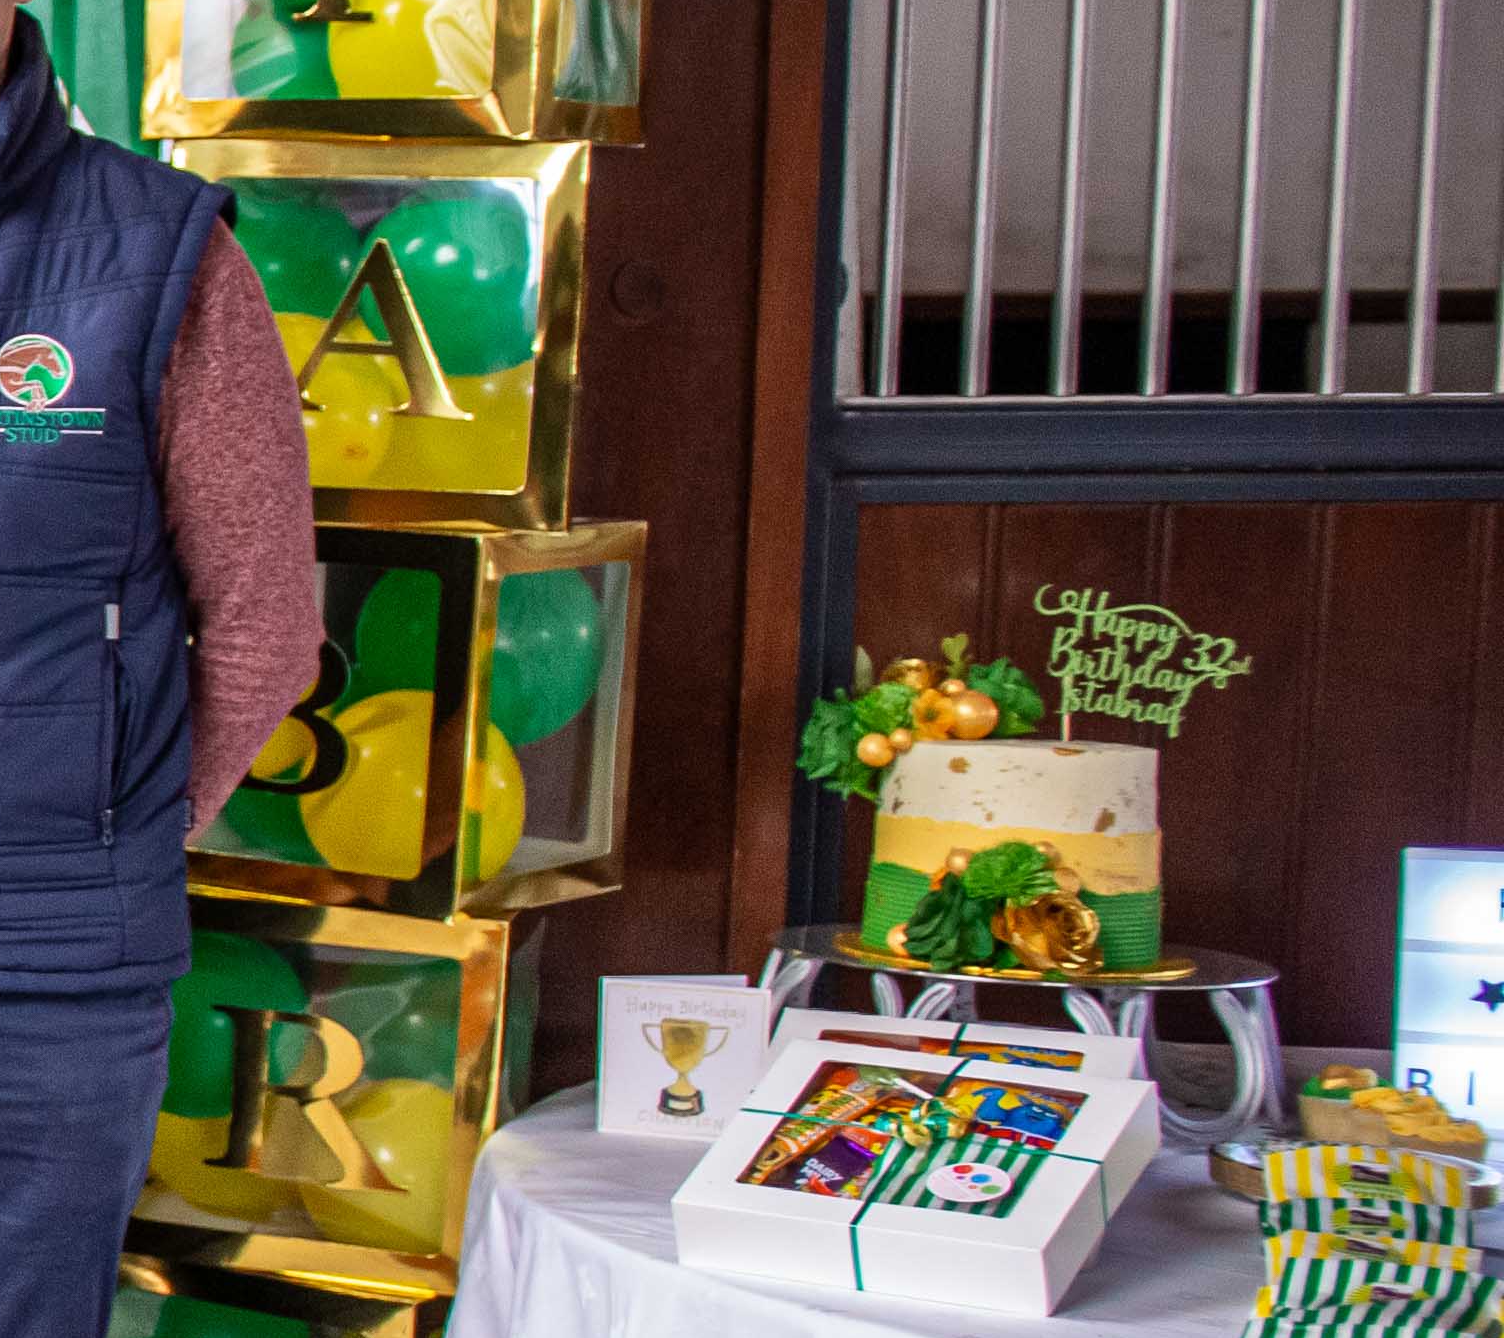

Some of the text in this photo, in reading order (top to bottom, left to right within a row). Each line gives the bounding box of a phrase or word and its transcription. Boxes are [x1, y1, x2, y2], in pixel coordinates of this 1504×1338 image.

[4, 426, 60, 443] STUD
[1035, 584, 1182, 659] Happy
[1047, 626, 1196, 707] Birthday
